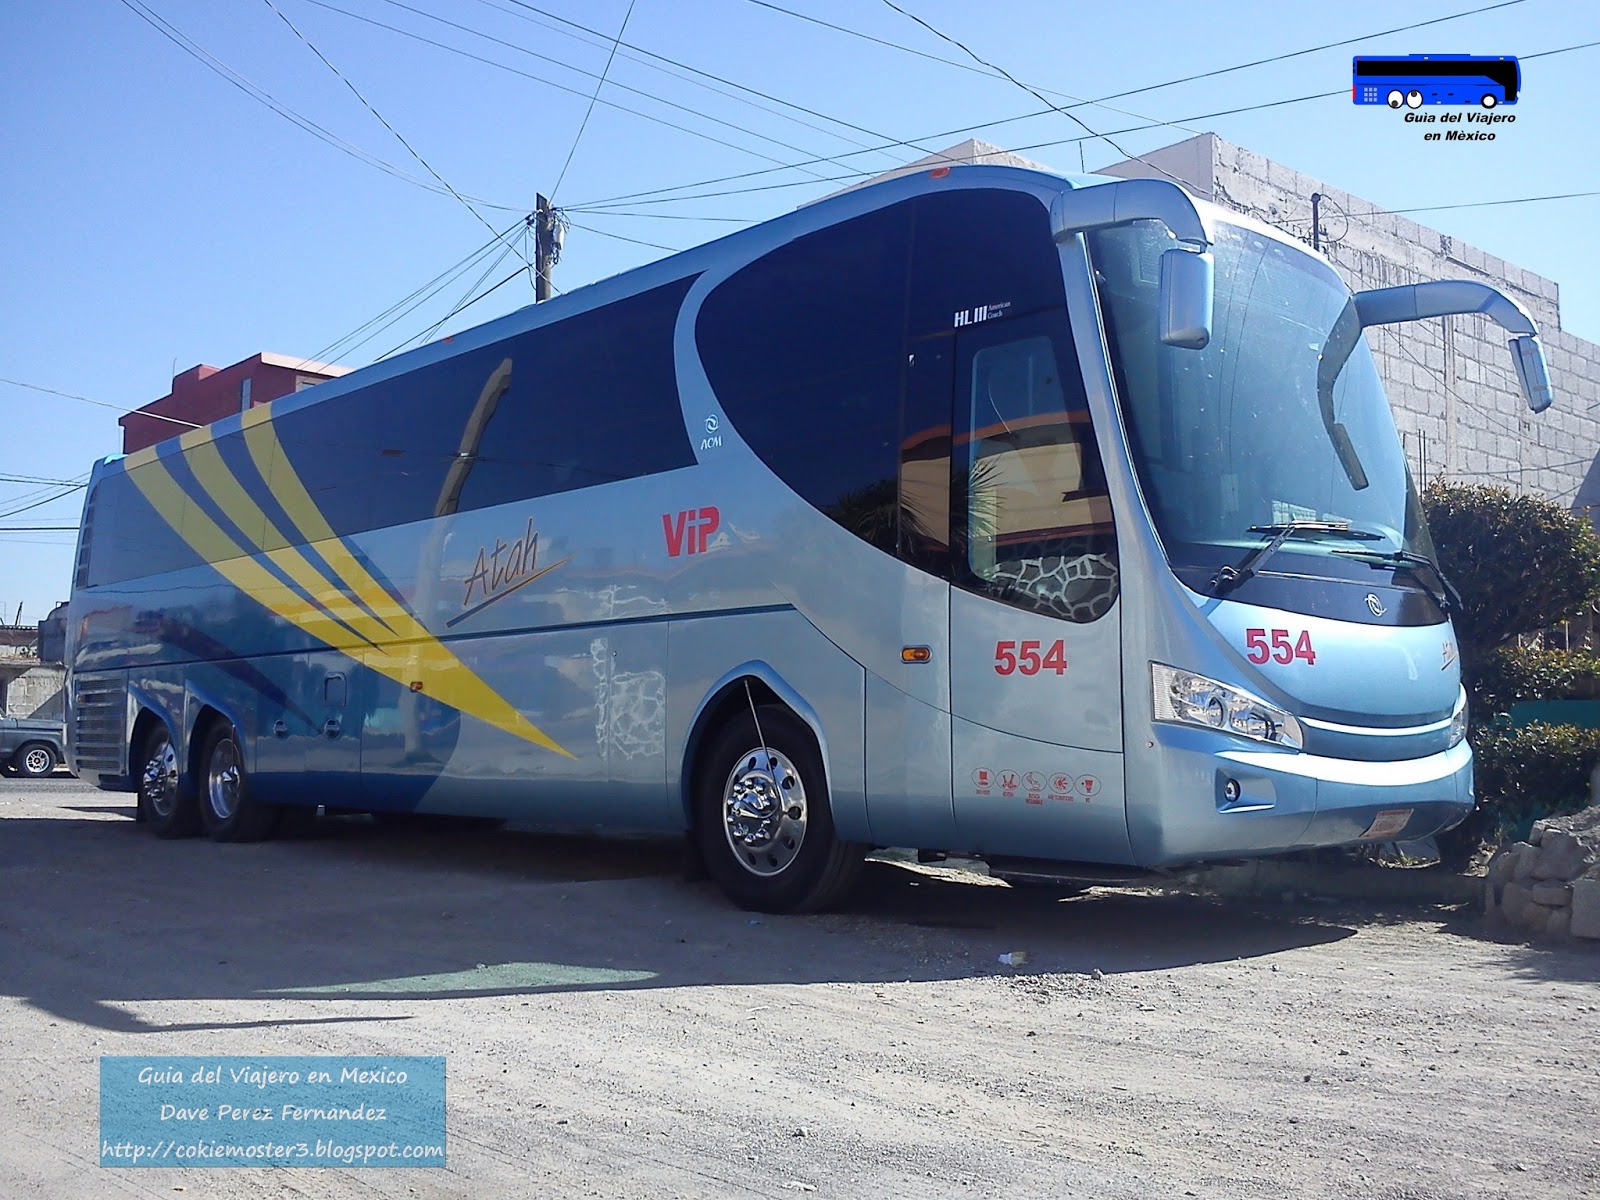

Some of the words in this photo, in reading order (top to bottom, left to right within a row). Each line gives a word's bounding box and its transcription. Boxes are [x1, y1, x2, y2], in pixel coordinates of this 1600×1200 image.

[988, 301, 1011, 311] American
[987, 310, 1003, 319] Coach
[700, 436, 722, 450] ACM
[1246, 628, 1316, 666] 554
[994, 639, 1067, 676] 554
